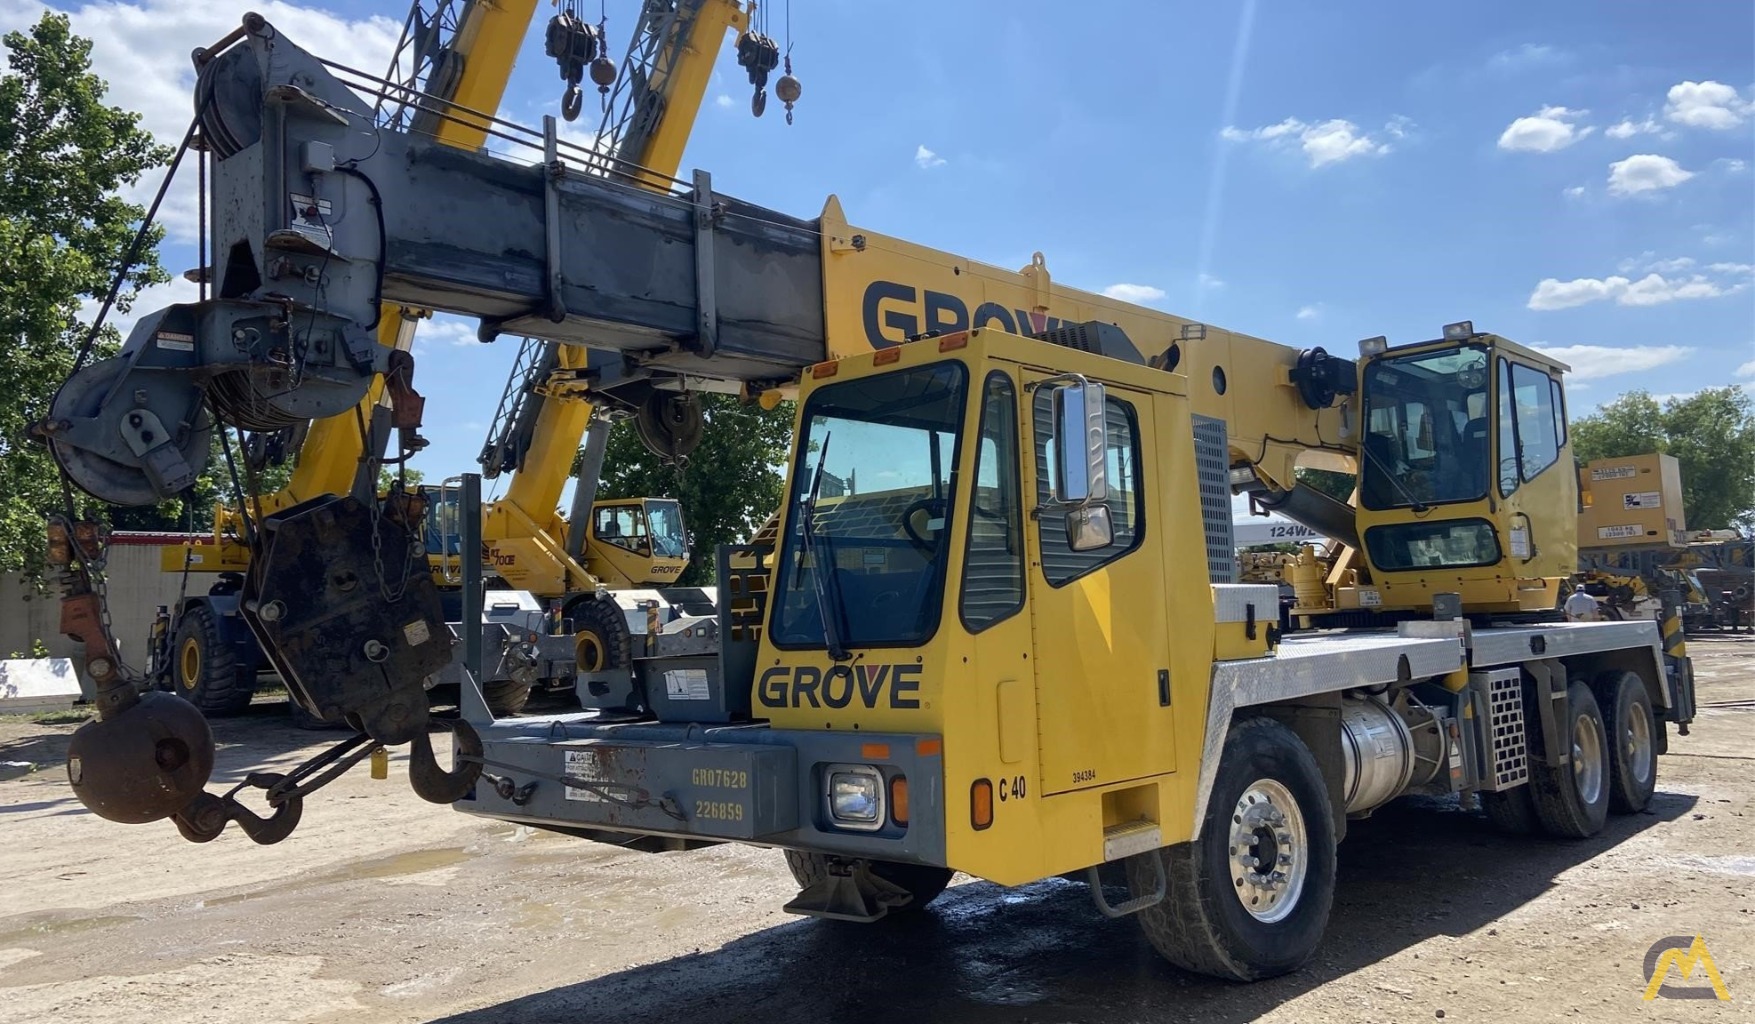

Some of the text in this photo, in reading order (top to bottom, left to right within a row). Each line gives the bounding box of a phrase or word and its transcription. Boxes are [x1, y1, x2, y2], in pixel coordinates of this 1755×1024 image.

[650, 566, 682, 574] GROVE
[758, 664, 923, 709] GROVE
[1072, 769, 1096, 784] 394384
[1000, 775, 1026, 802] C 40
[696, 800, 743, 821] 226859
